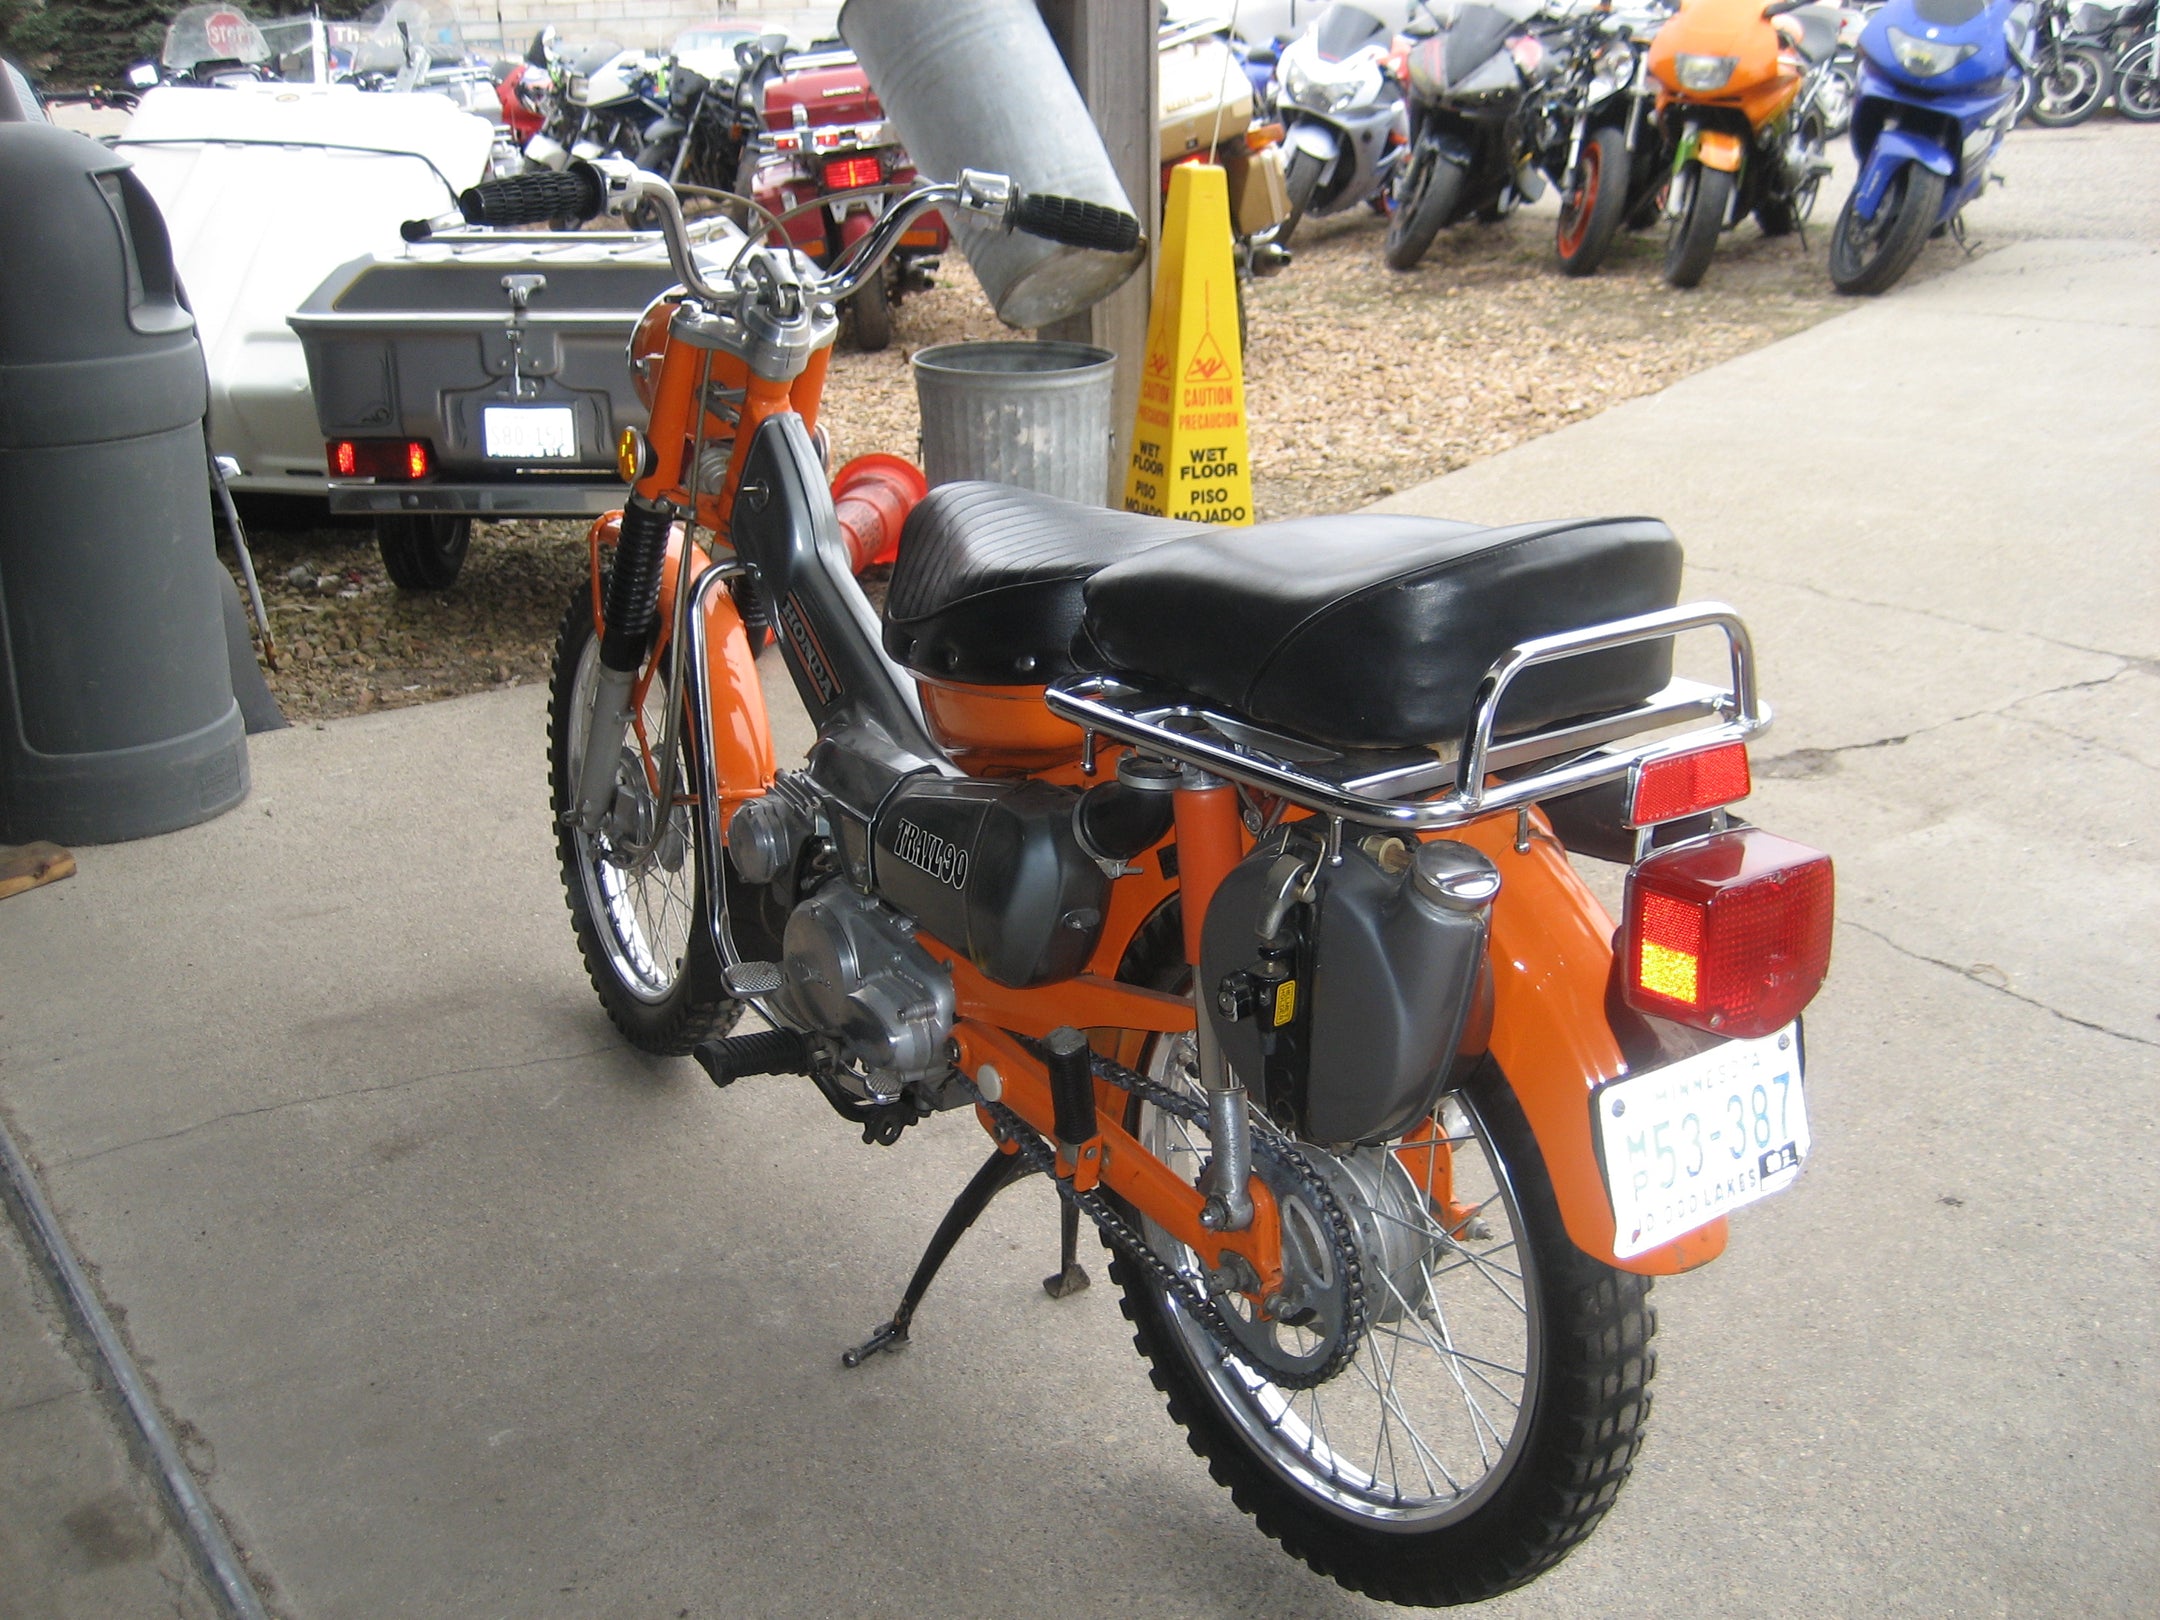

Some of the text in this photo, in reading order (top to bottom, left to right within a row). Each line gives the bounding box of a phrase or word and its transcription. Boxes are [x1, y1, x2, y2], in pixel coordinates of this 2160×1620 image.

[1184, 387, 1233, 408] CAUTION
[1179, 412, 1239, 430] PRECAUCION
[1139, 440, 1161, 458] WET
[1190, 447, 1228, 463] WET
[1133, 455, 1164, 477] FLOOR
[1180, 463, 1238, 480] FLOOR
[1135, 480, 1156, 500] PISO
[1190, 488, 1228, 505] PISO
[1174, 507, 1246, 524] MOJADO
[781, 599, 833, 701] HONDA
[1655, 1052, 1761, 1101] MINNESOA
